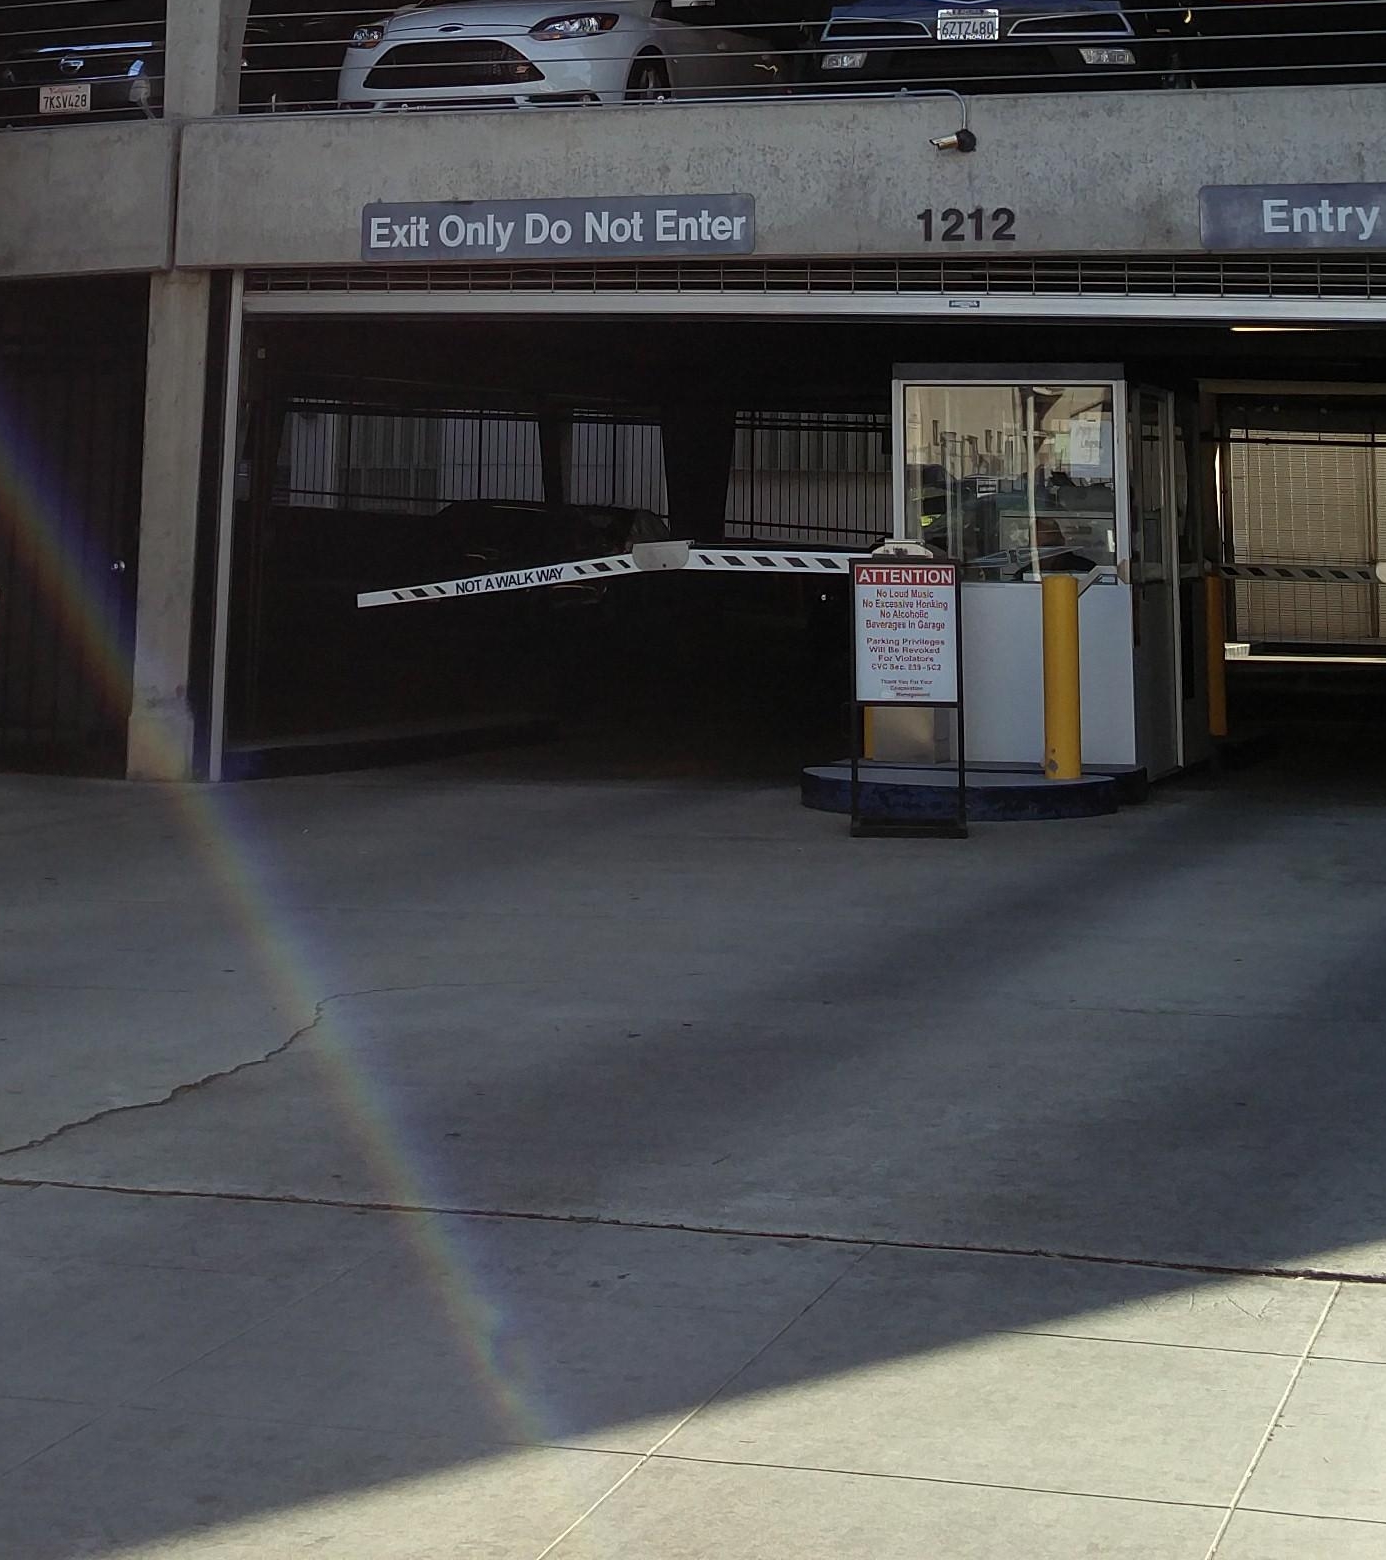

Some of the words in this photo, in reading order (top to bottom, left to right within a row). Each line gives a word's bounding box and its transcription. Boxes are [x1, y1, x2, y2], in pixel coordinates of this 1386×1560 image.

[43, 94, 87, 110] 7KSV428
[917, 208, 1016, 242] 1212
[1262, 198, 1381, 240] Entry
[370, 217, 429, 248] Exit
[439, 214, 515, 252] Only
[525, 213, 572, 245] Do
[585, 211, 644, 243] Not
[656, 210, 746, 241] Enter
[455, 580, 481, 594] NOT
[485, 578, 494, 590] A
[495, 572, 534, 588] WALK
[536, 567, 564, 582] WAY
[858, 569, 952, 584] ATTENTION
[877, 589, 887, 598] No
[890, 589, 908, 598] Loud
[911, 589, 934, 598] Music
[863, 599, 873, 608] No
[875, 600, 914, 608] Excessive
[916, 600, 948, 611] Honking
[880, 610, 891, 619] No
[893, 610, 928, 619] Alcoholic
[866, 620, 906, 631] Beverages
[909, 620, 916, 629] In
[918, 620, 945, 631] Garage
[867, 638, 899, 646] Parking
[903, 638, 945, 646] Privileges
